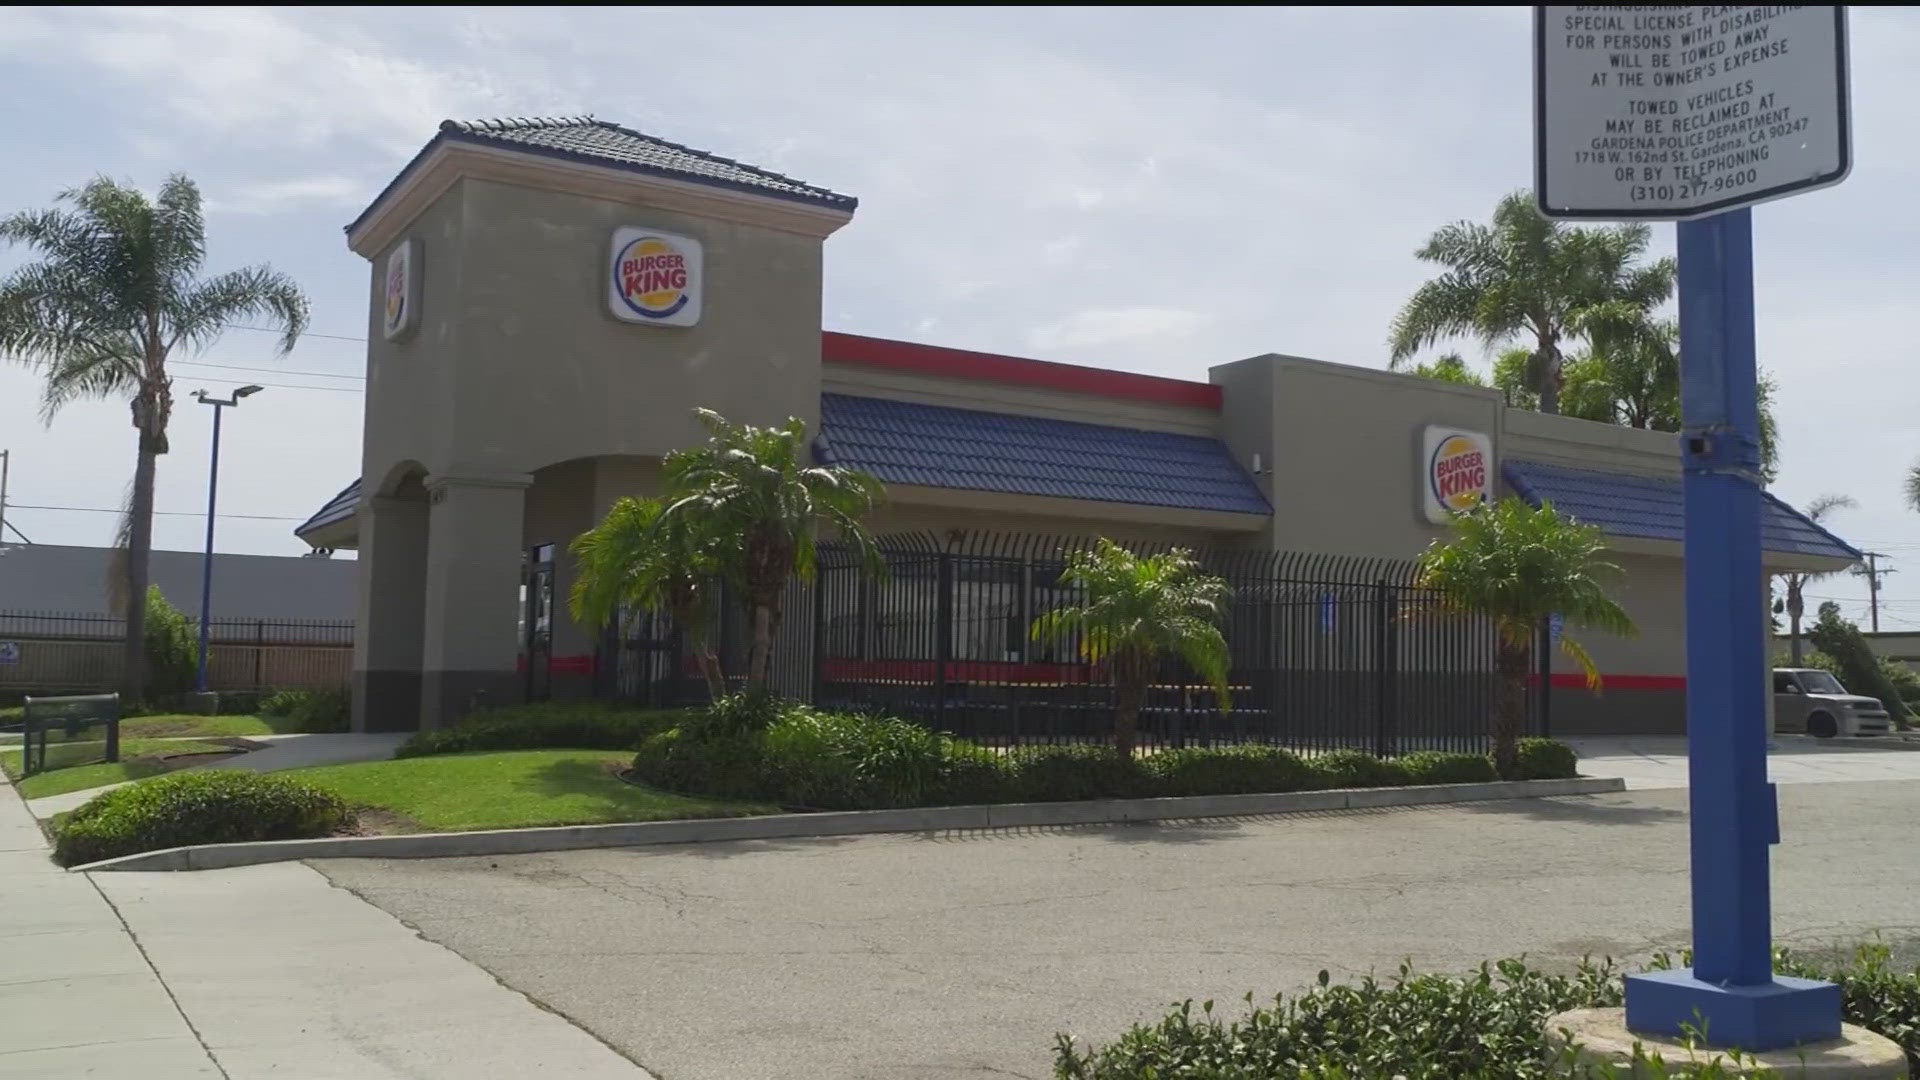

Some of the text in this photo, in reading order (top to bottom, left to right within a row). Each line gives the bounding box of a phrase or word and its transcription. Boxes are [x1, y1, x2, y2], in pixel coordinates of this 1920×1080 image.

[1565, 6, 1744, 31] SPECIAL LICENSE PLA
[1566, 6, 1802, 49] FOR PERSONS WITH DISABILIT
[1591, 38, 1788, 87] AT THE OWNER'S EXPENSE
[1610, 24, 1769, 68] WILL BE TOWED AWAY
[1606, 92, 1775, 134] MAY BE RECLAIMED AT
[1629, 80, 1754, 115] TOWED VEHICLES
[1575, 151, 1605, 164] 1718
[1628, 150, 1668, 163] 162nd
[1671, 149, 1689, 162] St.
[1748, 129, 1766, 144] CA
[1769, 117, 1808, 138] 90247
[1591, 107, 1790, 150] GARDENA POLICE DEPARTMENT
[1615, 145, 1770, 182] OR BY TELEPHONING
[1630, 168, 1758, 203] (310) 217-9600
[623, 254, 685, 277] BURGER
[625, 269, 687, 299] KING
[1437, 452, 1484, 478] BURGER
[1440, 467, 1486, 500] KING
